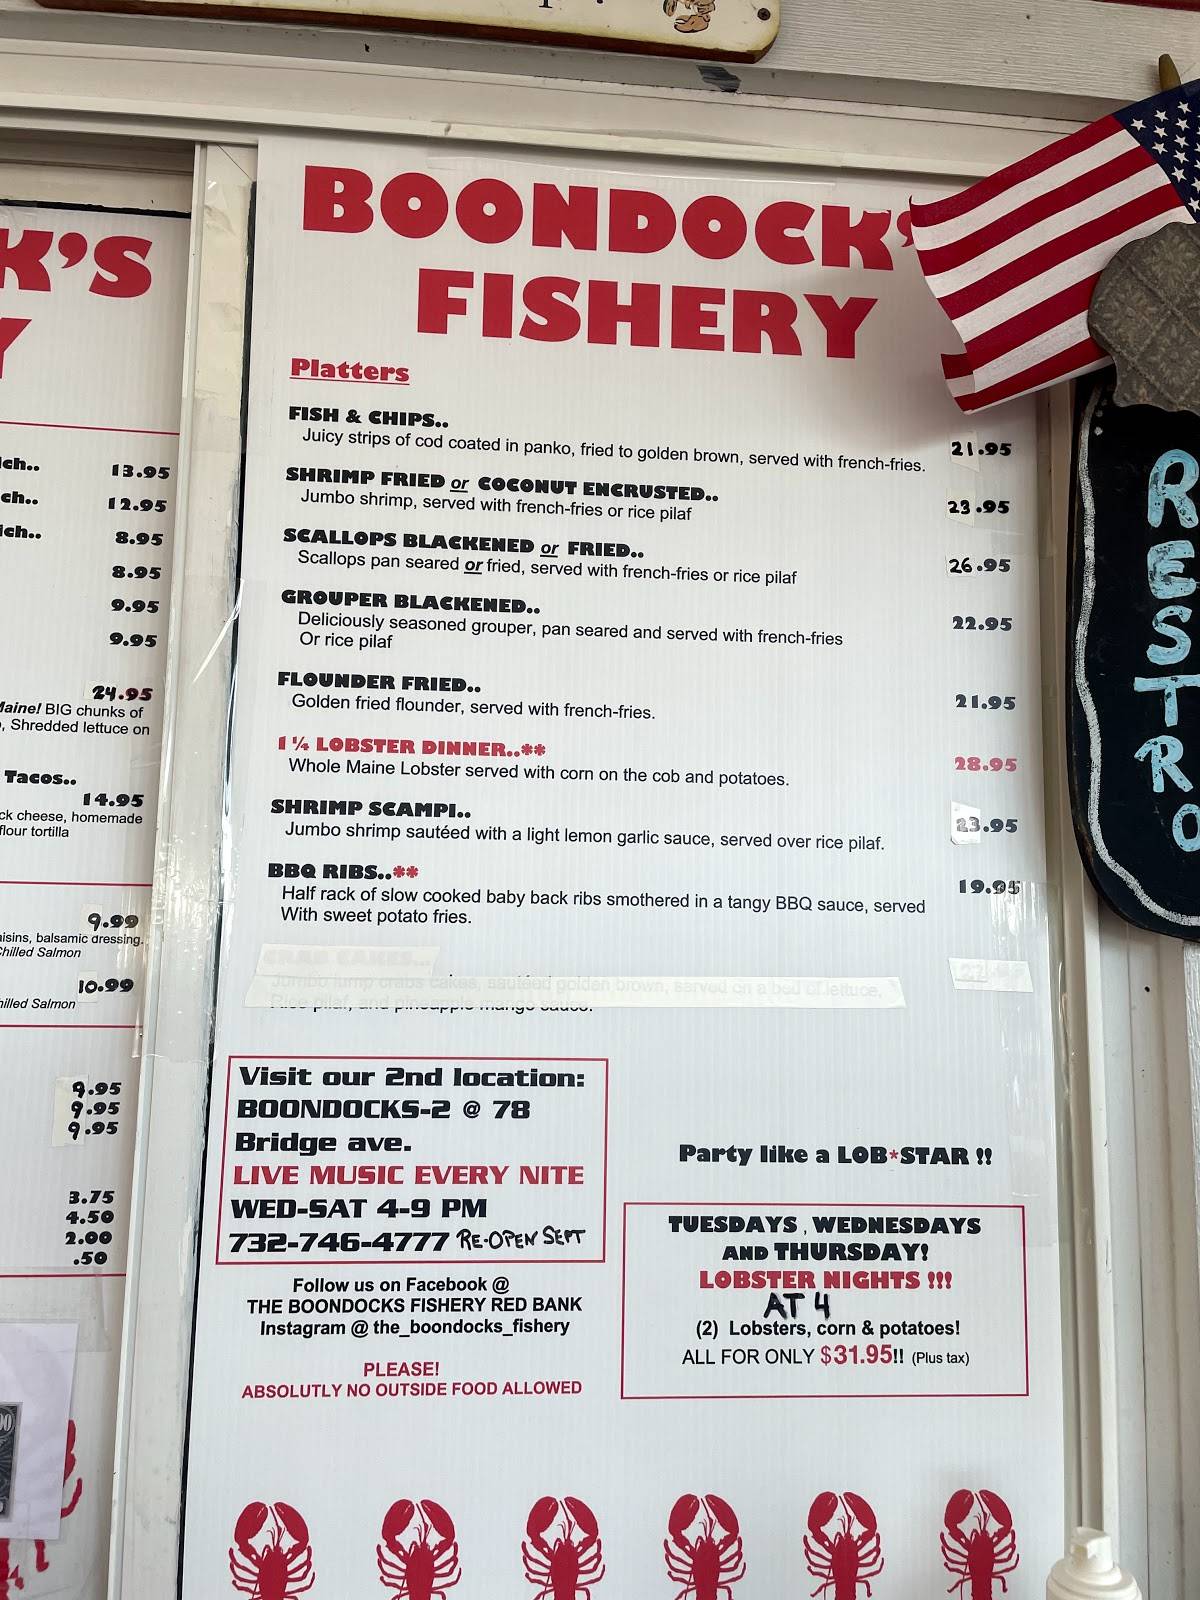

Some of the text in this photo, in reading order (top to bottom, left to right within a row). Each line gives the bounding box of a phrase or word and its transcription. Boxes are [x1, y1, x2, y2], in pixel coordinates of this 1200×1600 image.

[417, 268, 879, 359] FISHERY
[291, 358, 409, 384] Platters
[289, 406, 449, 428] FISH & CHIPS..
[952, 441, 1011, 456] 21.95
[112, 464, 170, 480] 13.95
[285, 467, 719, 502] SHRIMP FRIED or COCONUT ENCRUSTED..
[108, 497, 166, 513] 12.95
[301, 488, 692, 523] Jumbo shrimp, served with french-fries or rice pilaf
[947, 499, 1010, 515] 23.95
[115, 531, 163, 546] 8.95
[283, 528, 644, 558] SCALLOPS BLACKENED or FRIED..
[112, 565, 161, 580] 8.95
[949, 557, 1011, 574] 26.95
[111, 598, 160, 614] 9.95
[281, 589, 540, 614] GROUPER BLACKENED..
[952, 616, 1012, 631] 22.95
[109, 632, 158, 648] 9.95
[277, 671, 481, 693] FLOUNDER FRIED..
[92, 685, 154, 702] 24.95
[955, 694, 1016, 710] 21.95
[45, 703, 144, 719] BIG chunks of
[10, 718, 79, 733] Shredded
[83, 721, 129, 735] lettuce
[133, 726, 150, 736] on
[316, 737, 415, 754] LOBSTER
[955, 756, 1016, 771] 28.95
[4, 770, 77, 786] Tacos..
[289, 758, 789, 787] Whole Maine Lobster served with corn on the cob and potatoes.
[83, 792, 145, 808] 14.95
[17, 810, 143, 824] cheese, homemade
[270, 799, 471, 819] SHRIMP SCAMPI..
[31, 826, 69, 838] tortilla
[957, 817, 1018, 833] 23.95
[268, 863, 316, 879] BBQ
[959, 879, 1020, 895] 19.95
[88, 913, 139, 932] 9.99
[36, 932, 144, 947] balsamic dressing.
[37, 947, 81, 958] Salmon
[78, 978, 134, 994] 10.99
[31, 998, 76, 1009] Salmon
[239, 1066, 584, 1087] Visit our 2nd location:
[237, 1099, 530, 1119] BOONDOCKS-2 @ 78
[235, 1132, 412, 1156] Bridge ave.
[679, 1144, 753, 1166] Party
[760, 1145, 808, 1163] like
[816, 1149, 830, 1164] a
[976, 1147, 992, 1165] !!
[233, 1165, 584, 1185] LIVE MUSIC EVERY NITE
[69, 1190, 115, 1204] 3.75
[230, 1198, 487, 1219] WED-SAT 4-9 PM
[66, 1210, 114, 1225] 4.50
[668, 1215, 981, 1235] TUESDAYS WEDNESDAYS
[65, 1231, 112, 1245] 2.00
[229, 1232, 450, 1253] 732-746-4777
[456, 1225, 586, 1251] RE-OPEN SEPT
[73, 1251, 107, 1265] .50
[722, 1242, 929, 1261] AND THURSDAY!
[293, 1276, 510, 1295] Follow us on Facebook @
[700, 1270, 952, 1289] LOBSTER NIGHTS !!!
[247, 1297, 582, 1314] THE BOONDOCKS FISHERY RED BANK
[763, 1291, 831, 1321] AT 4
[260, 1318, 570, 1339] Instagram @ the_boondocks_fishery
[696, 1320, 960, 1340] (2) Lobsters, corn & potatoes!
[682, 1349, 716, 1365] ALL
[721, 1348, 760, 1365] FOR
[765, 1348, 815, 1364] ONLY
[912, 1352, 943, 1367] (Plus
[946, 1352, 970, 1367] tax)
[364, 1361, 439, 1377] PLEASE!
[241, 1381, 582, 1399] ABSOLUTLY NO OUTSIDE FOOD ALLOWED
